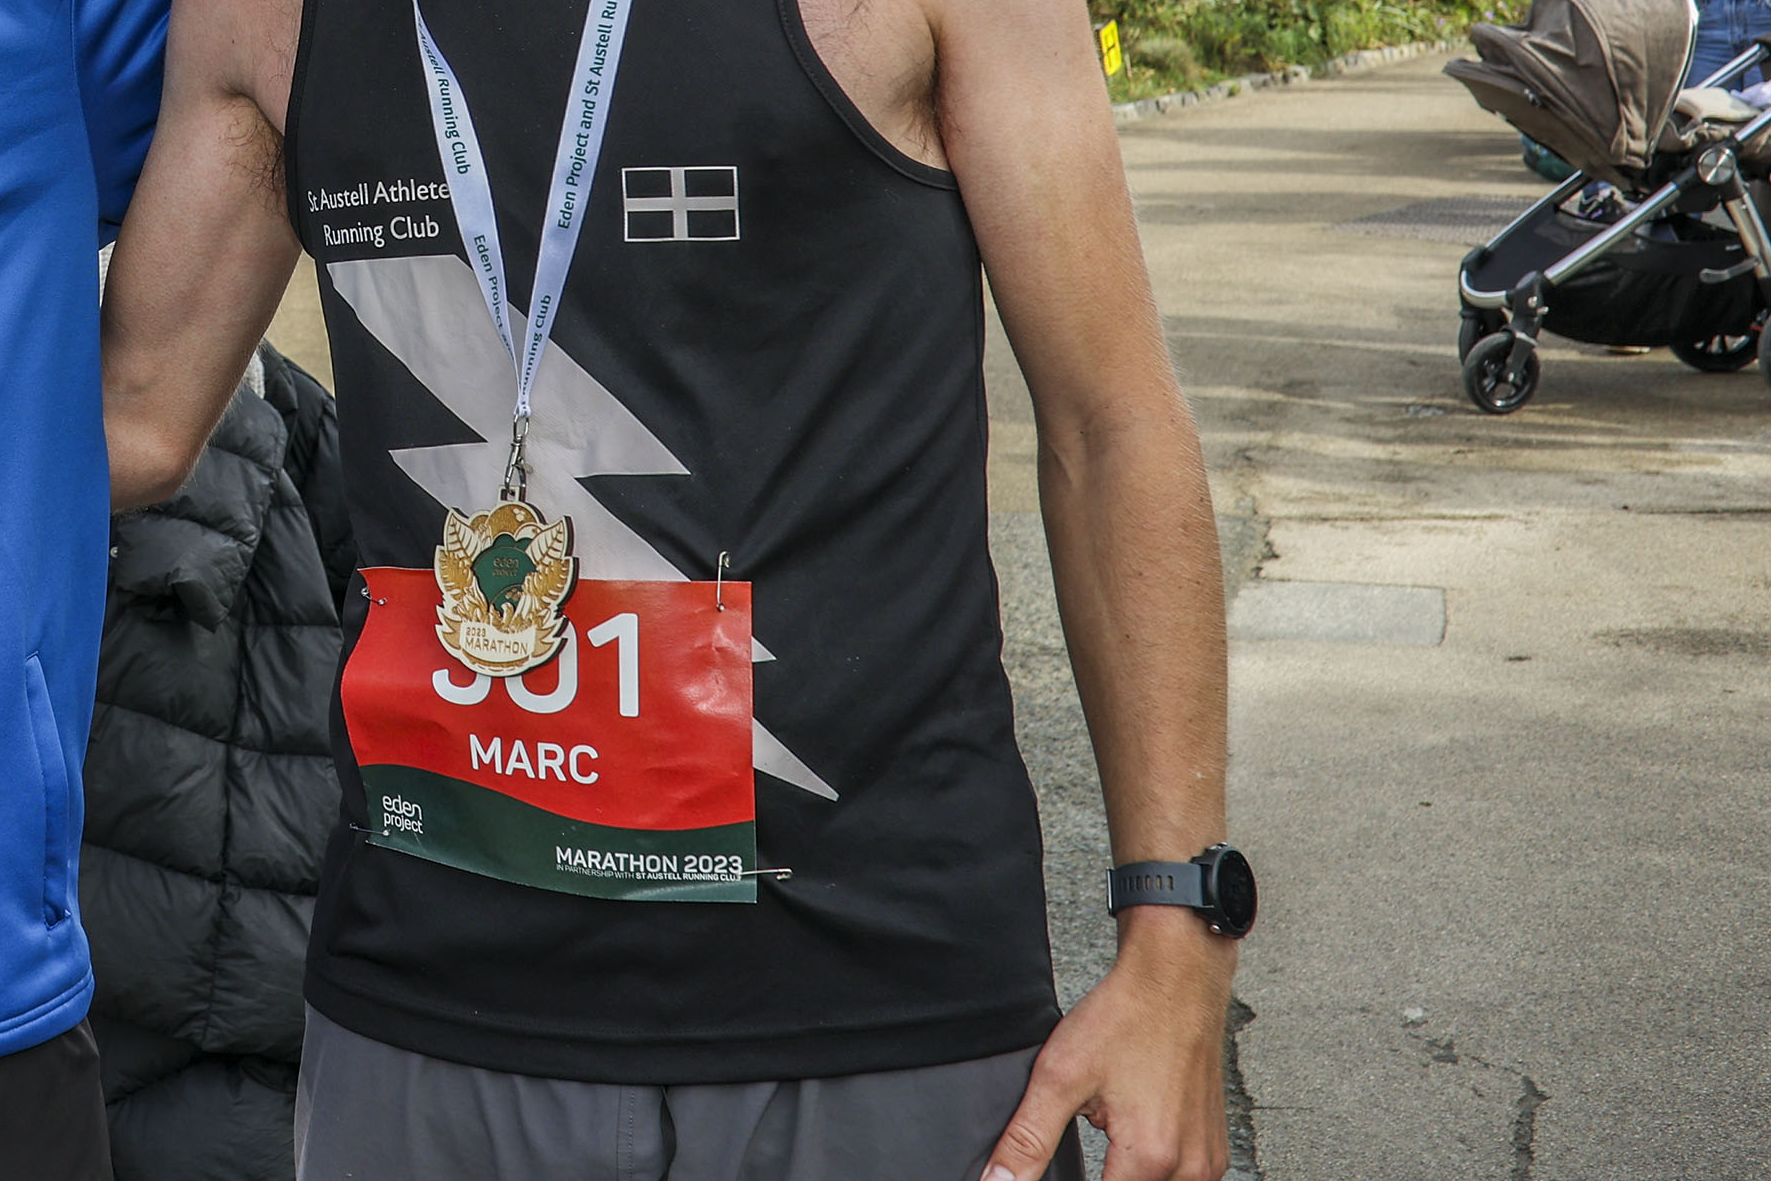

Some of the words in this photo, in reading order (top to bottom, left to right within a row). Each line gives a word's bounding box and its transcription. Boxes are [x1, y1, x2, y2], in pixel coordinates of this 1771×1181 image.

[589, 24, 613, 77] Austell
[419, 30, 446, 75] Austell
[438, 78, 460, 139] Running
[452, 141, 471, 175] Club
[585, 79, 601, 96] St
[580, 99, 596, 130] and
[566, 133, 590, 187] Project
[307, 191, 319, 213] St
[320, 182, 369, 211] Austell
[558, 191, 577, 230] Eden
[323, 221, 386, 248] Running
[390, 215, 440, 240] Club
[474, 234, 493, 273] Eden
[489, 276, 503, 329] Project
[535, 294, 552, 329] Club
[465, 637, 528, 655] MARATHON
[468, 733, 599, 785] MARC
[382, 794, 423, 821] eden
[383, 812, 424, 834] project
[556, 845, 677, 873] MARATHON
[683, 855, 743, 874] 2023
[556, 863, 564, 871] IN
[565, 865, 614, 878] PARTNERSHIP
[614, 871, 635, 880] WITH
[636, 872, 646, 880] ST
[647, 872, 681, 881] AUSTELL
[682, 873, 719, 881] RUNNING
